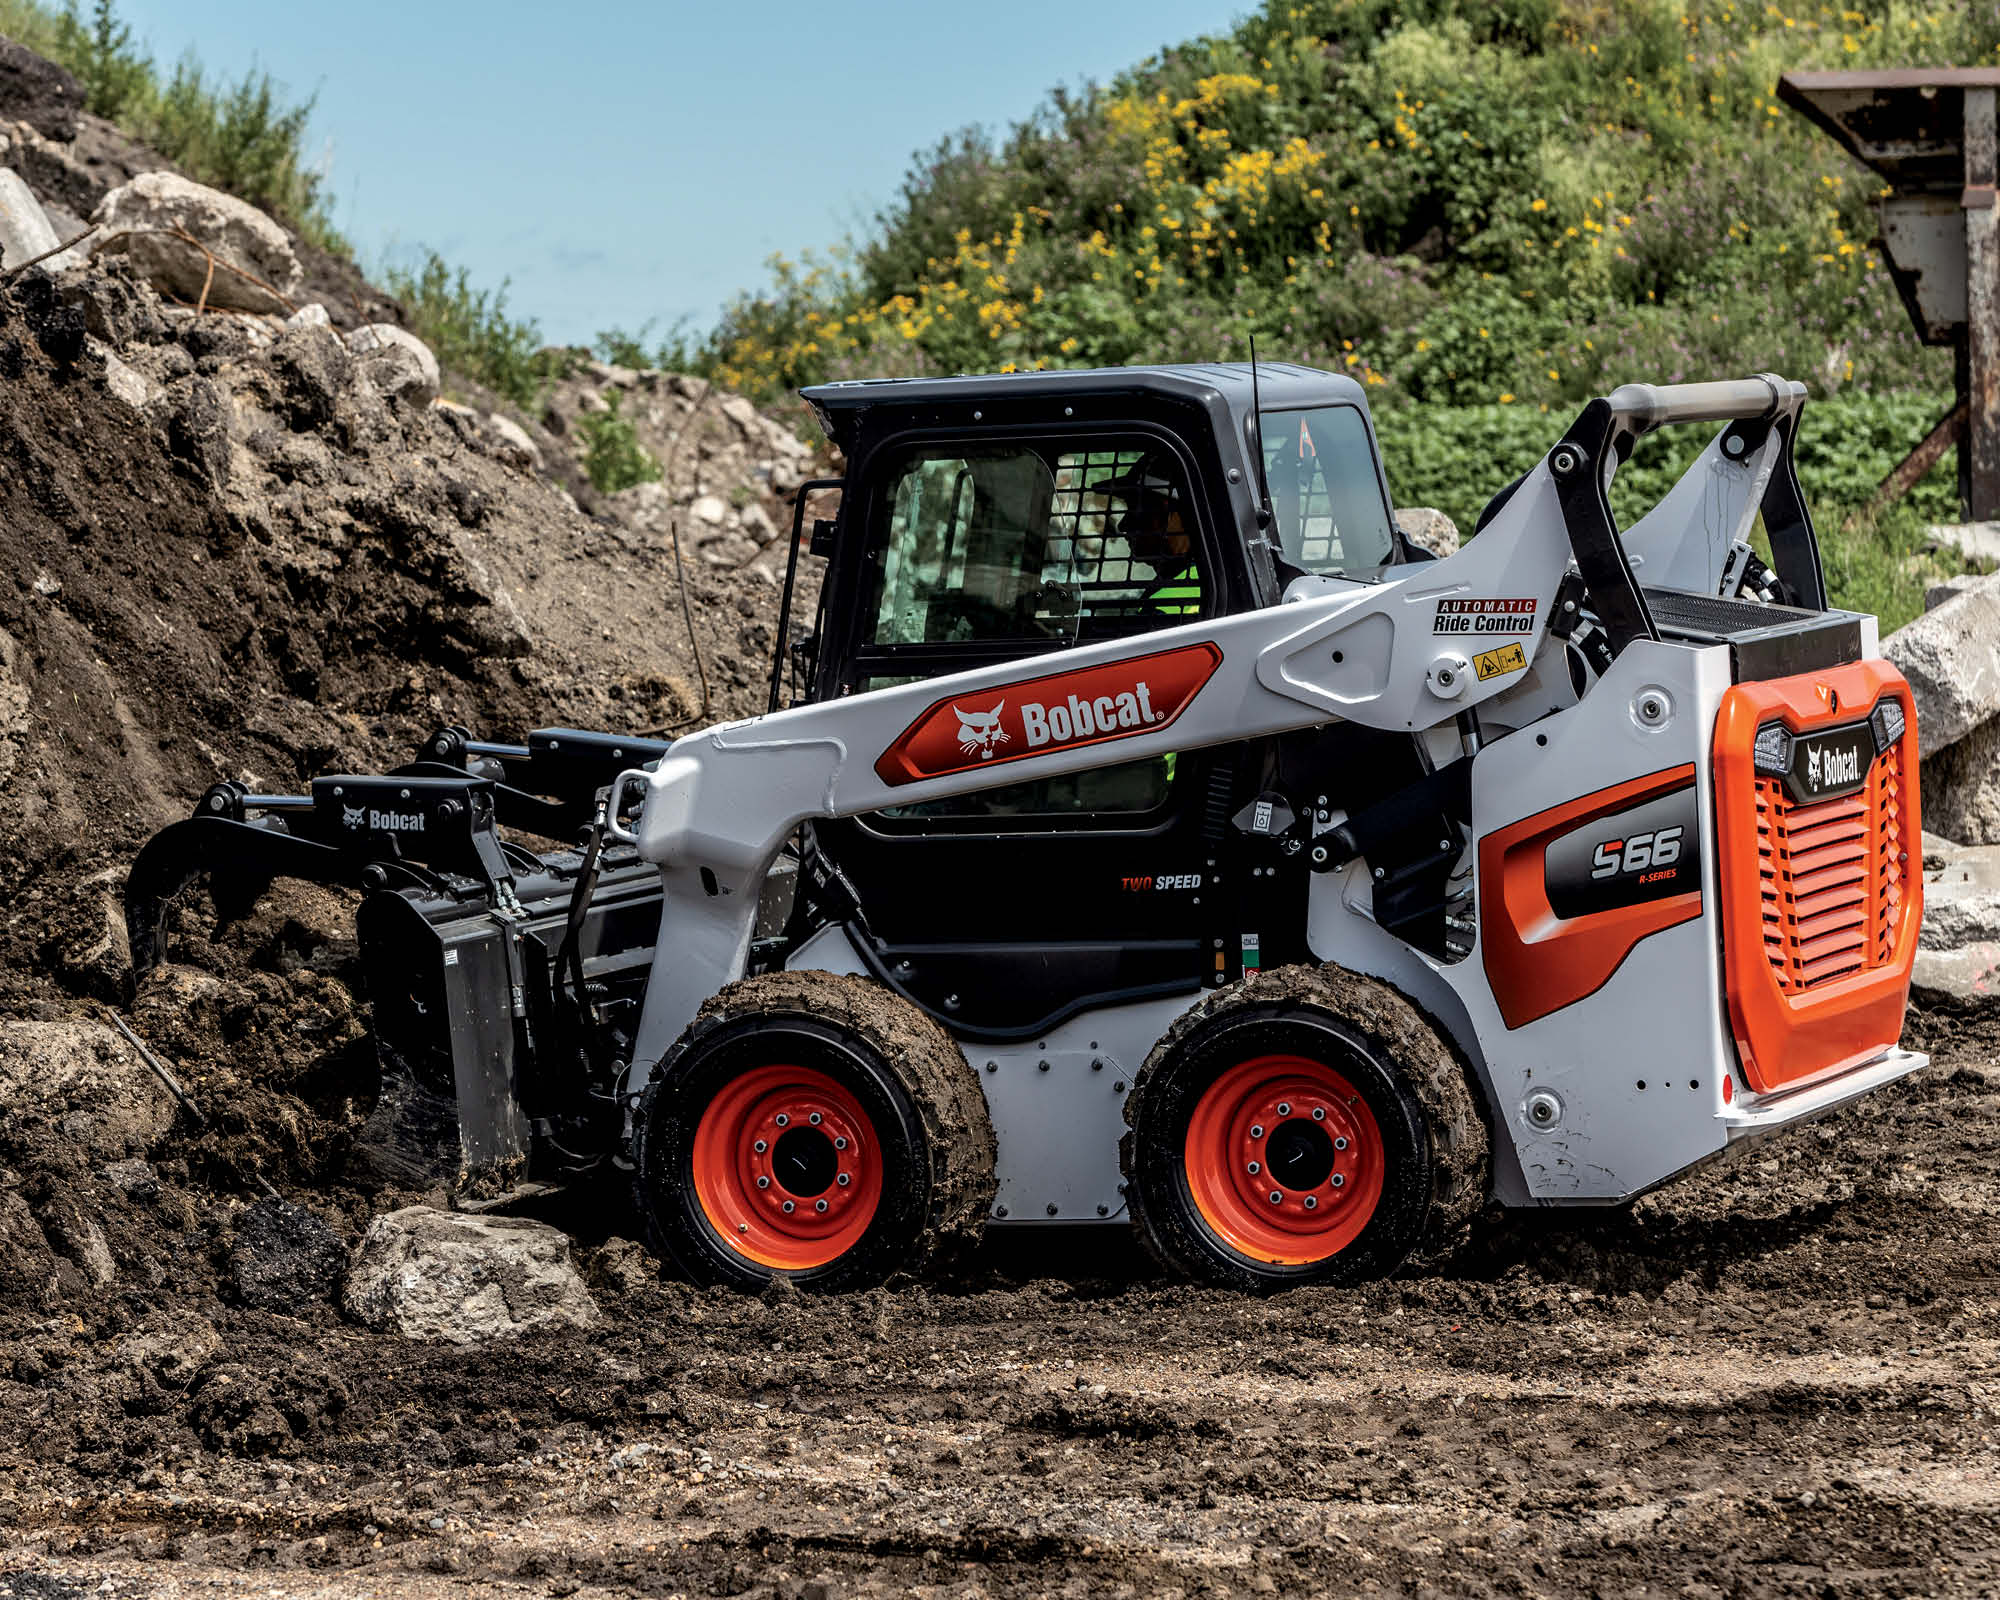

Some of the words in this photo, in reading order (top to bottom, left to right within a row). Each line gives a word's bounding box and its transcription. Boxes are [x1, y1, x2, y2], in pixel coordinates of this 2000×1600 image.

[1440, 600, 1534, 613] AUTOMATIC
[1433, 614, 1471, 632] Ride
[1474, 614, 1535, 632] Control
[1020, 680, 1156, 748] Bobcat
[1823, 745, 1859, 787] Bobcat
[369, 809, 425, 831] Bobcat
[1591, 826, 1683, 880] S66
[1121, 876, 1153, 890] TWO
[1155, 874, 1202, 890] SPEED
[1639, 868, 1678, 885] R-SERIES
